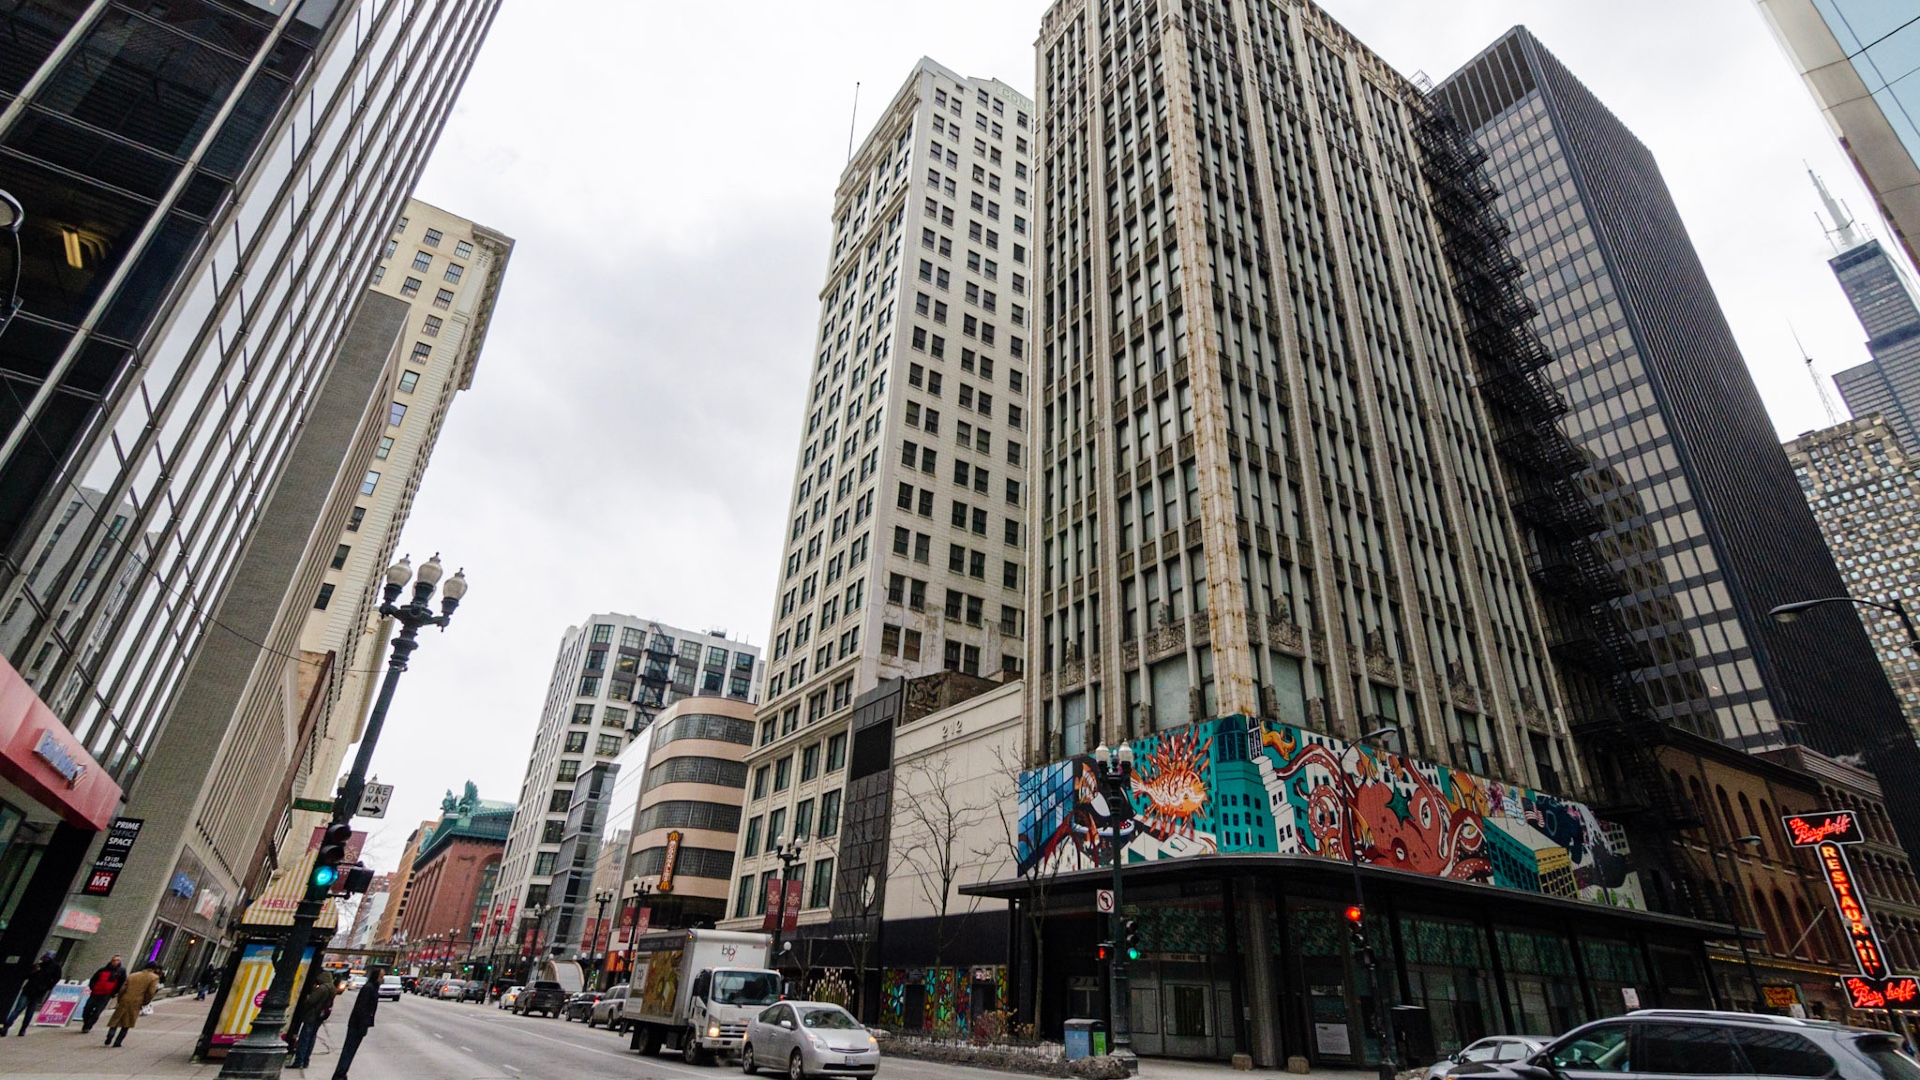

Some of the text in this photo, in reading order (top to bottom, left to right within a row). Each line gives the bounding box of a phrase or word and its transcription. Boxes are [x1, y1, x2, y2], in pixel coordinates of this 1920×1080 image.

[942, 718, 963, 738] 212
[368, 785, 389, 795] ONE
[365, 795, 387, 805] WAY
[115, 820, 140, 830] PRIME
[111, 829, 138, 838] OFFICE
[108, 837, 133, 846] SPACE
[91, 875, 111, 886] MR
